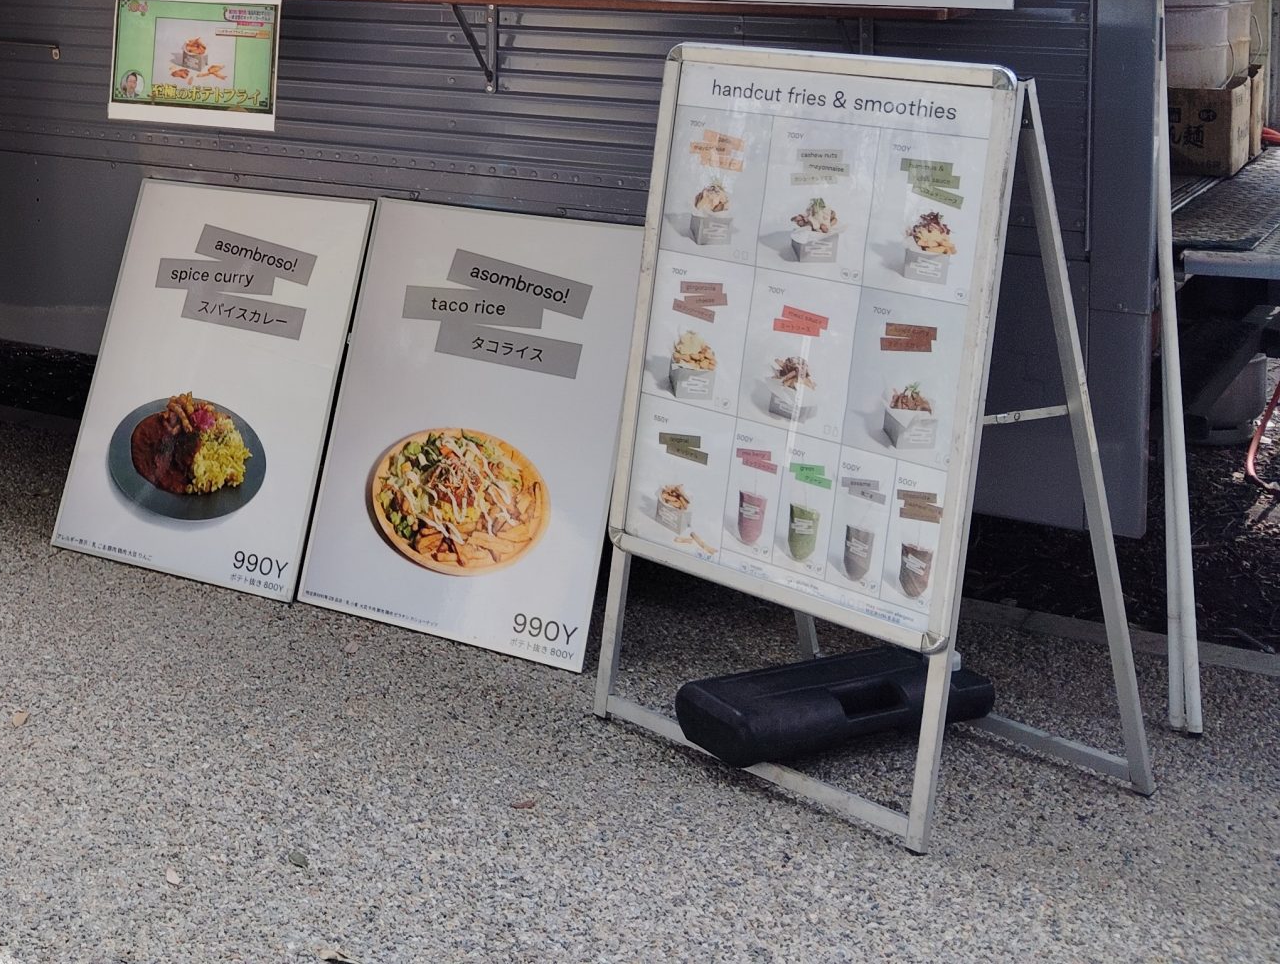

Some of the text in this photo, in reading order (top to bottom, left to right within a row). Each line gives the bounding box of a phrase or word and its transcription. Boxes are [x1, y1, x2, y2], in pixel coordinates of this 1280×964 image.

[712, 80, 957, 120] handcut fries & smoothies
[214, 240, 298, 272] asombroso!
[171, 268, 254, 287] spice curry
[470, 267, 570, 304] asombroso!
[198, 300, 288, 324] スパイスカレー
[431, 298, 506, 316] taco rice
[874, 306, 892, 315] 700Y
[472, 336, 544, 362] タコライス
[790, 449, 806, 458] 00Y
[233, 551, 288, 578] 990Y
[230, 574, 284, 592] ポテト抜き 800Y
[513, 614, 578, 645] 990Y
[510, 638, 574, 660] ポテト抜き 800Y
